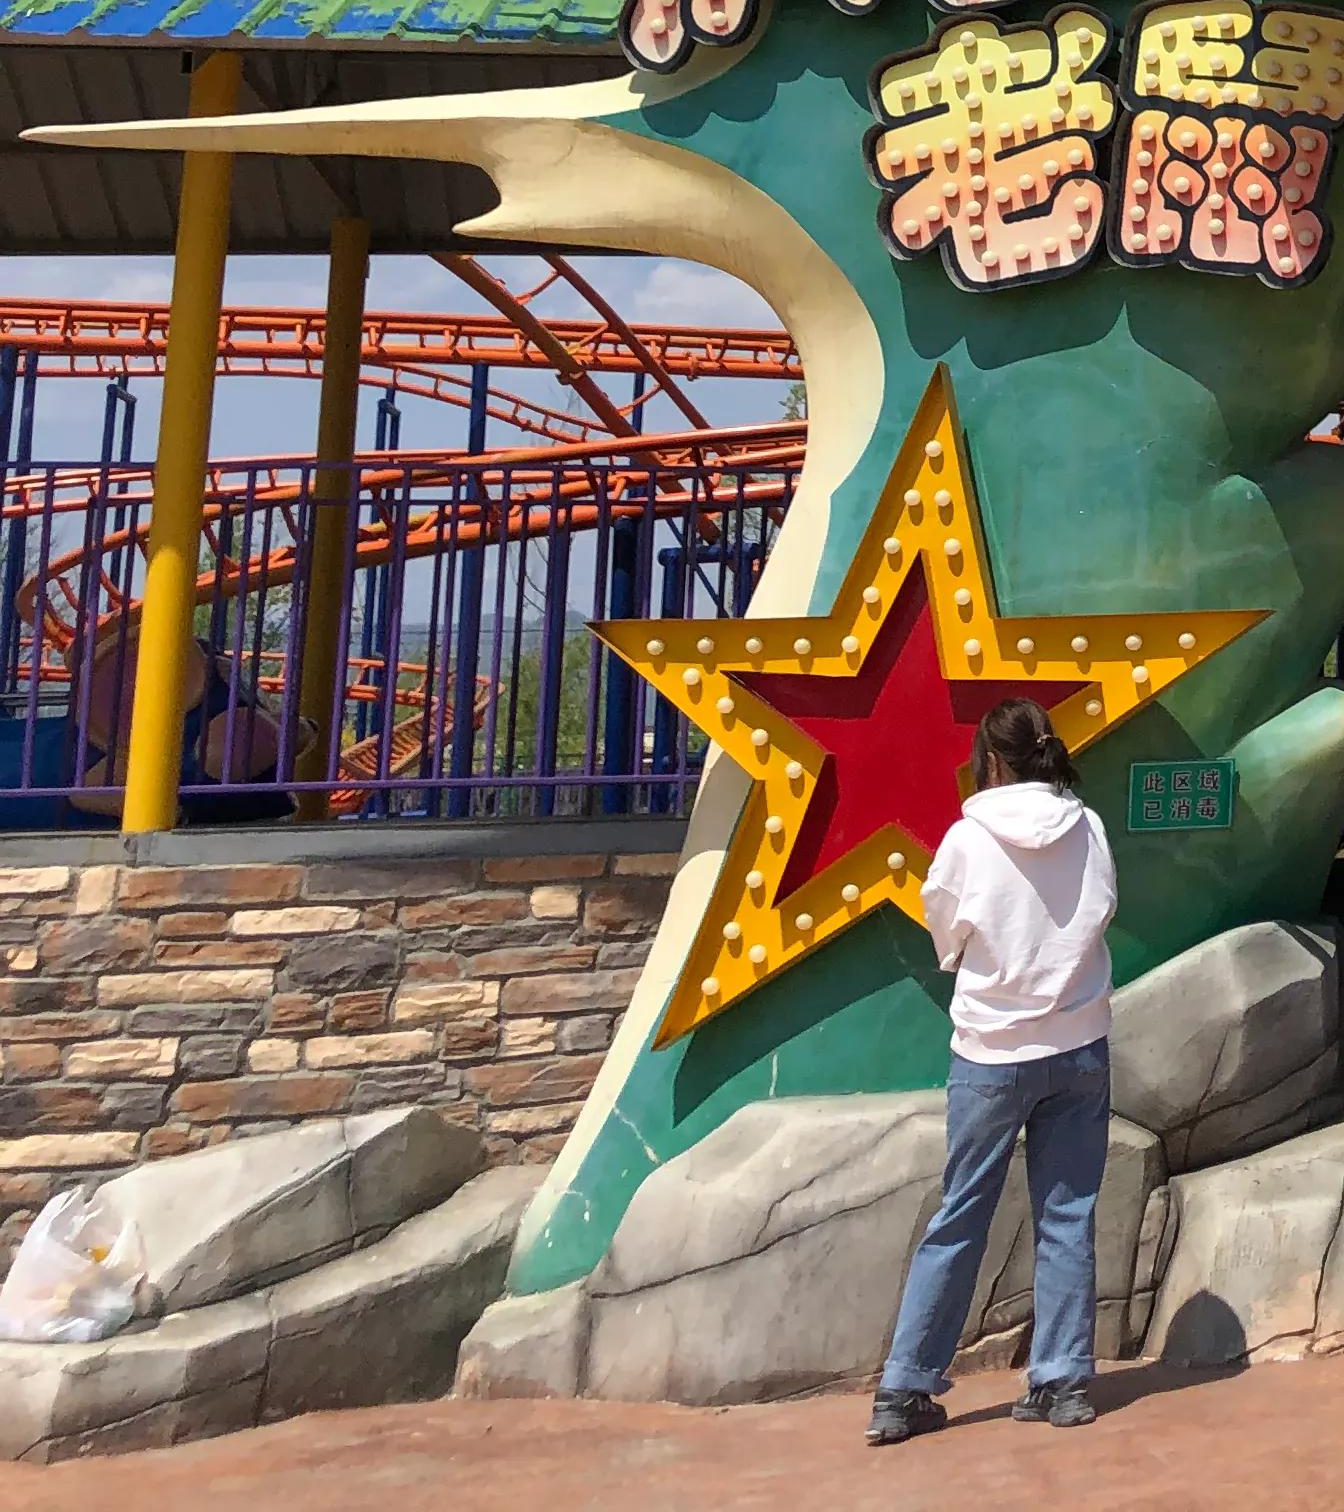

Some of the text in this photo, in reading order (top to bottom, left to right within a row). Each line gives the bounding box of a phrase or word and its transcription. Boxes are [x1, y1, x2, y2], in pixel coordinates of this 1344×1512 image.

[1143, 769, 1221, 793] 此区域
[1143, 796, 1219, 821] 已消毒
